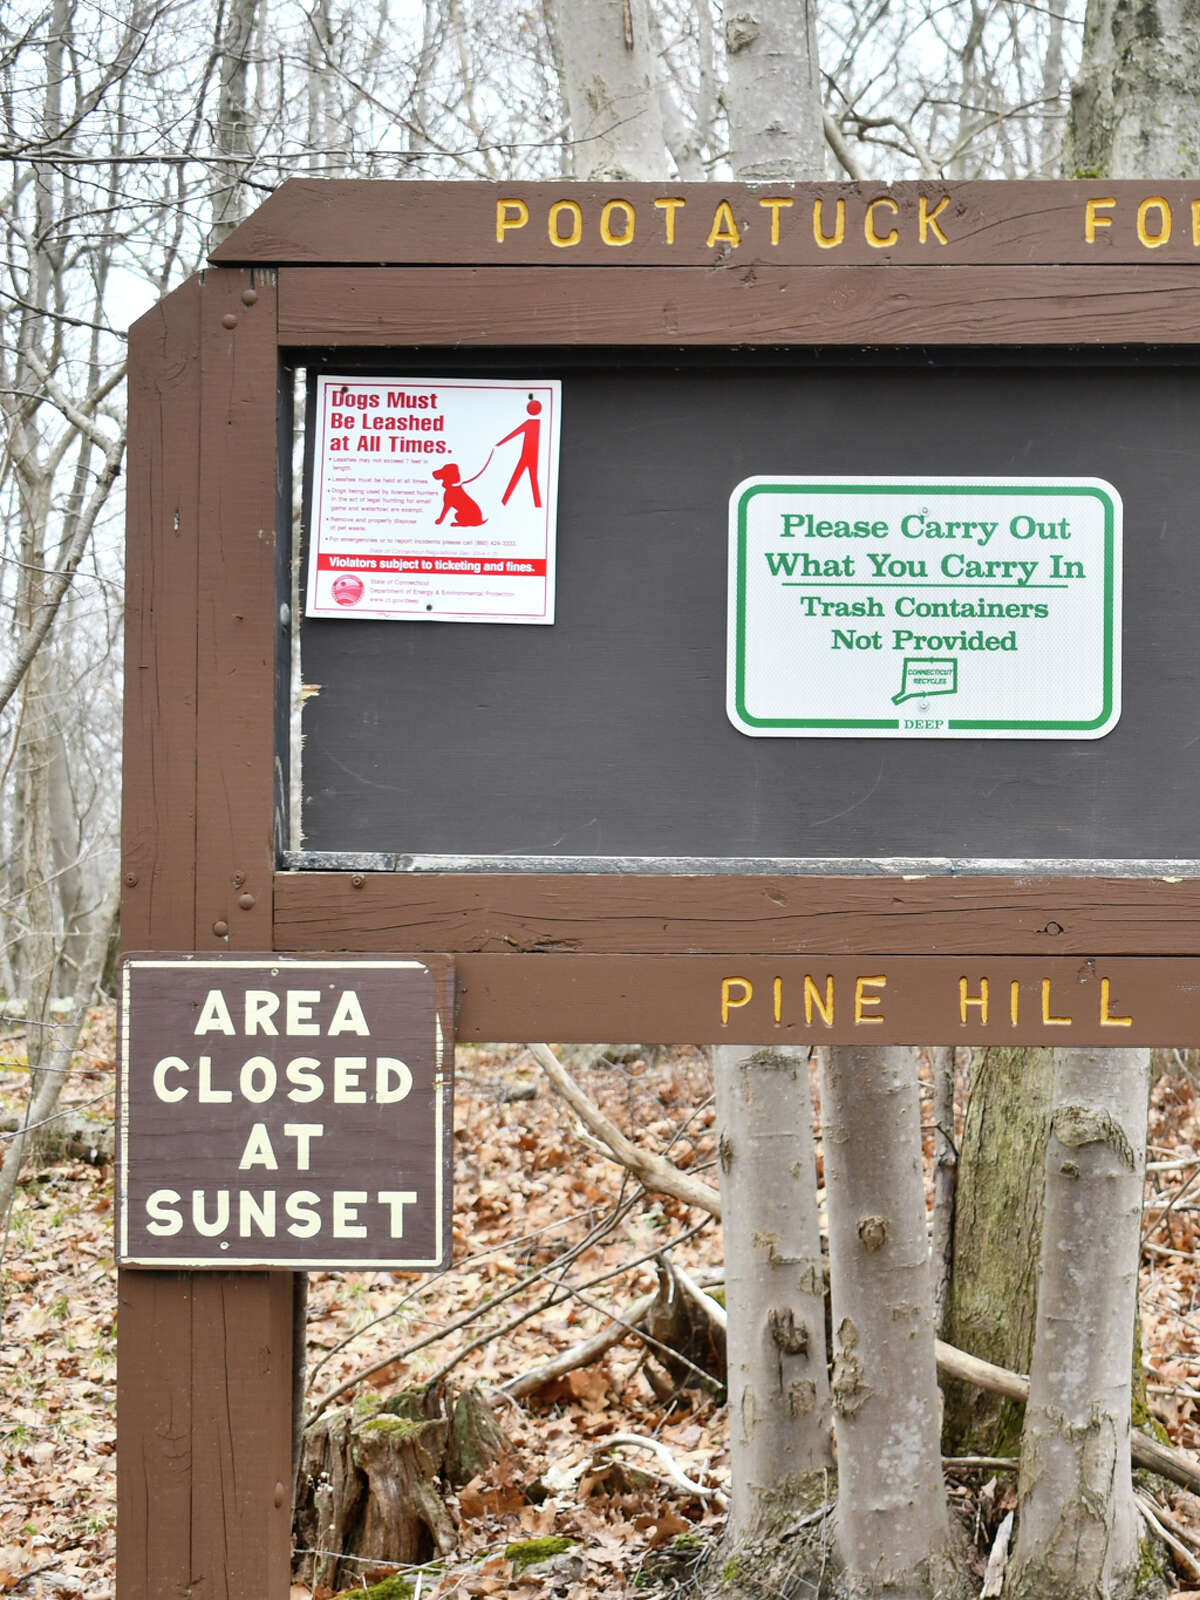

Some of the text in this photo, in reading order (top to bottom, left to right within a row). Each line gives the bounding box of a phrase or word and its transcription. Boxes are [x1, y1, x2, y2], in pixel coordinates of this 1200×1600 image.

[496, 198, 949, 246] POOTATUCK
[333, 391, 436, 409] Dogs Must
[332, 413, 444, 431] Be Leashed
[330, 436, 452, 453] at All Times.
[780, 514, 1071, 546] Please Carry Out
[328, 557, 535, 572] Violators subject to ticketing and fines.
[765, 552, 1085, 584] What You Carry In
[800, 596, 1048, 618] Trash Containers
[832, 630, 1018, 651] Not Provided
[904, 719, 944, 729] DEEP
[194, 990, 370, 1036] AREA
[721, 977, 1132, 1024] PINE HILL
[153, 1056, 413, 1103] CLOSED
[238, 1123, 323, 1170] AT
[146, 1190, 417, 1238] SUNSET
